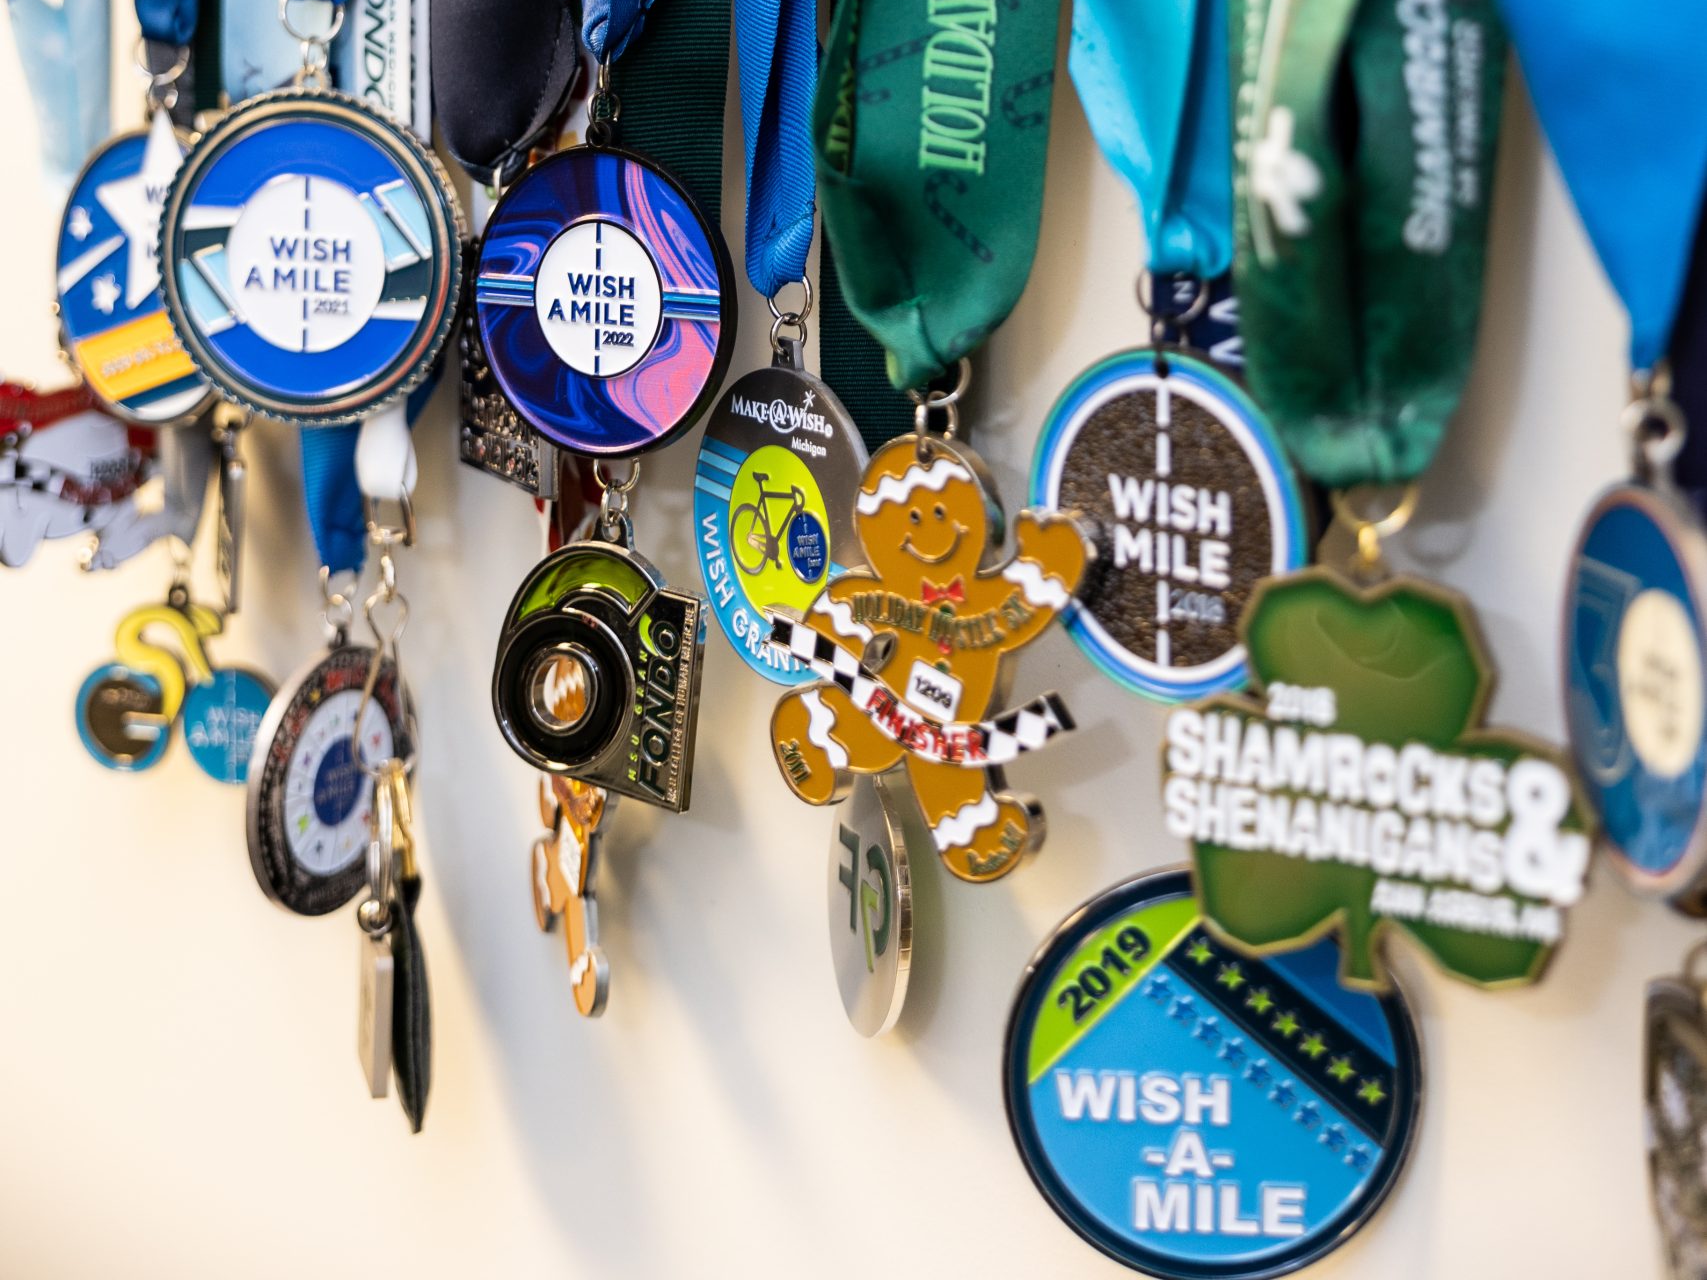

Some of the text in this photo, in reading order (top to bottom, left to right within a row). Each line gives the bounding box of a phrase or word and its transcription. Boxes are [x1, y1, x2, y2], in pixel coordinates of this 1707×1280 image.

[387, 32, 396, 112] MEDICIN
[245, 266, 352, 294] A MILE
[270, 237, 352, 263] WISH
[547, 298, 635, 327] A MILE
[567, 272, 635, 299] WISH
[602, 330, 635, 348] 2022
[791, 436, 828, 458] Michigan
[1107, 473, 1233, 537] WISH
[1114, 524, 1233, 589] MILE
[703, 513, 804, 672] WISH GRAN
[628, 649, 649, 782] MSU GRAN
[637, 620, 684, 801] FONDO
[864, 687, 990, 764] FINISHER
[1163, 774, 1505, 895] SHENANIGANS
[1504, 757, 1592, 907] &
[1054, 921, 1154, 1023] 2019
[1054, 1068, 1231, 1126] WISH
[1143, 1127, 1234, 1179] -A-
[1131, 1176, 1307, 1237] MILE
